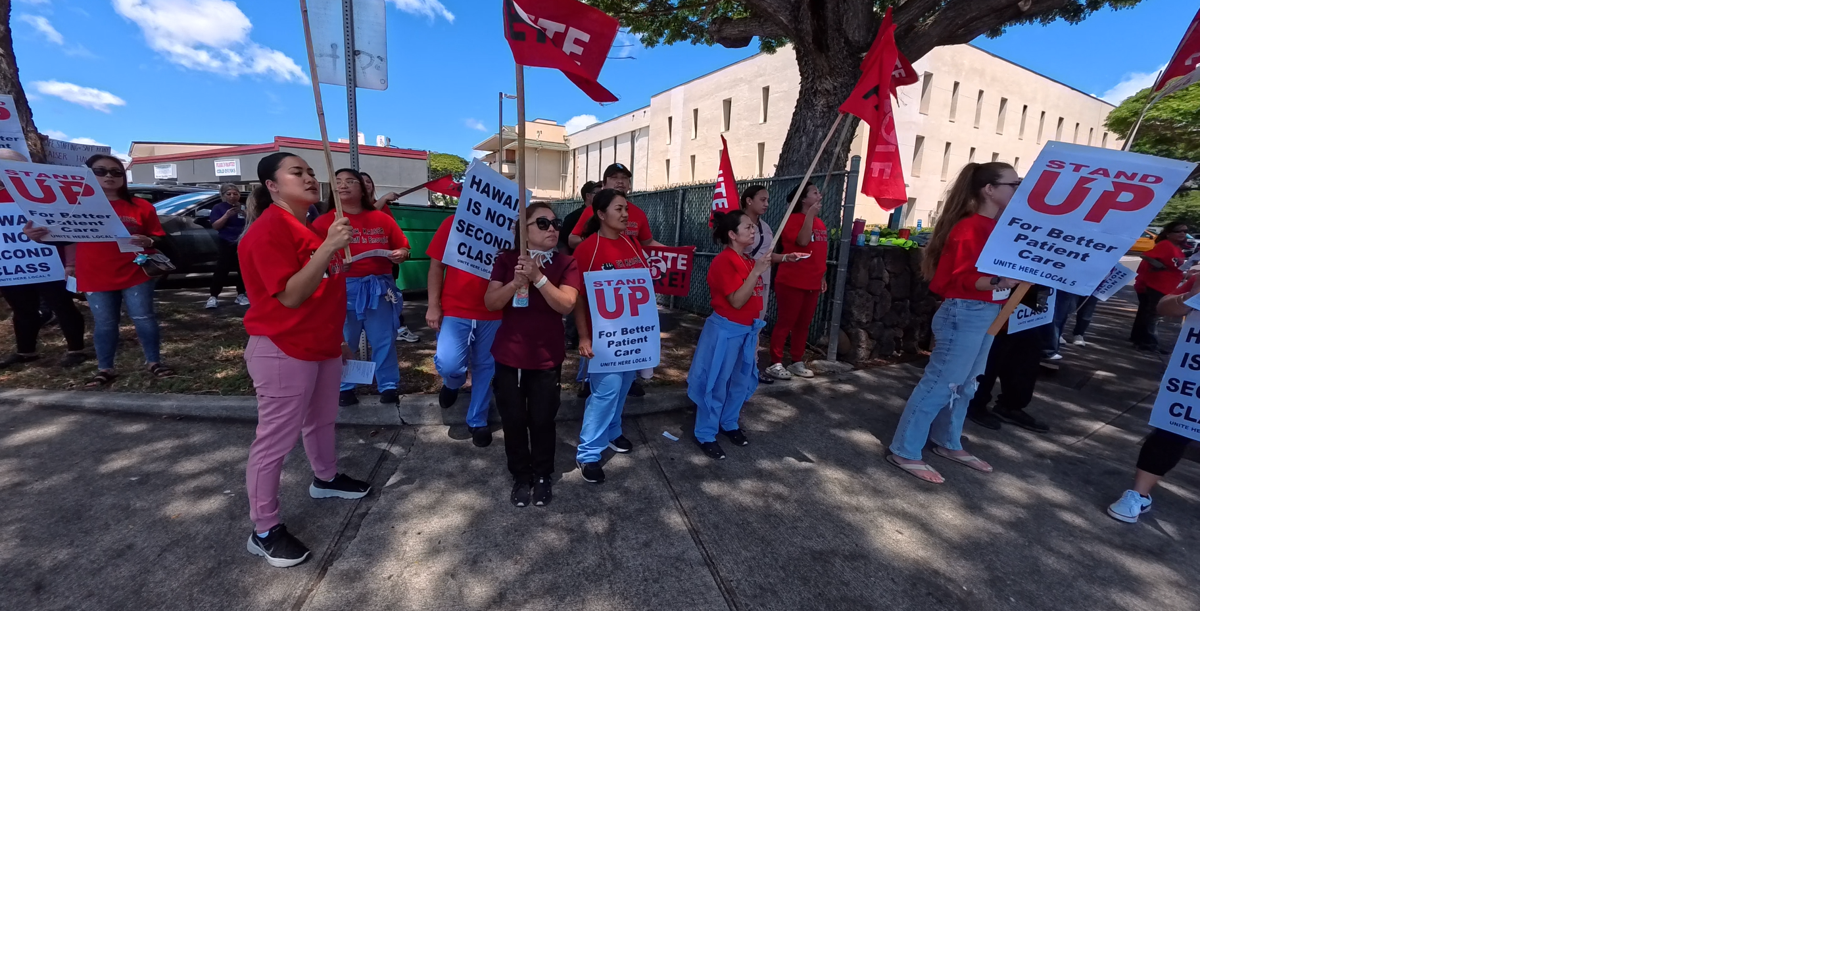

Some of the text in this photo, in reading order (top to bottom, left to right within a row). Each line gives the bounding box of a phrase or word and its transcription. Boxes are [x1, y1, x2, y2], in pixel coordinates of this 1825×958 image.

[48, 151, 68, 160] AISER
[4, 169, 86, 180] STAND
[1045, 159, 1164, 185] STAND
[8, 176, 95, 205] UP
[470, 175, 520, 213] HAWAI
[1027, 170, 1155, 224] UP
[28, 210, 55, 219] For
[467, 198, 514, 232] IS NOT
[456, 219, 512, 251] SECOND
[1007, 216, 1119, 253] For Better
[0, 247, 53, 260] COND
[1013, 233, 1091, 262] Patient
[0, 262, 51, 276] LASS
[1017, 249, 1066, 270] Care
[993, 258, 1017, 270] UNITE
[1018, 265, 1039, 276] HERE
[1039, 271, 1067, 285] LOCAL
[593, 278, 647, 287] STAND
[594, 286, 650, 320] UP
[598, 324, 656, 339] For Better
[607, 335, 648, 348] Patient
[614, 348, 641, 357] Care
[1168, 402, 1200, 424] CL
[1169, 420, 1190, 431] UNITE
